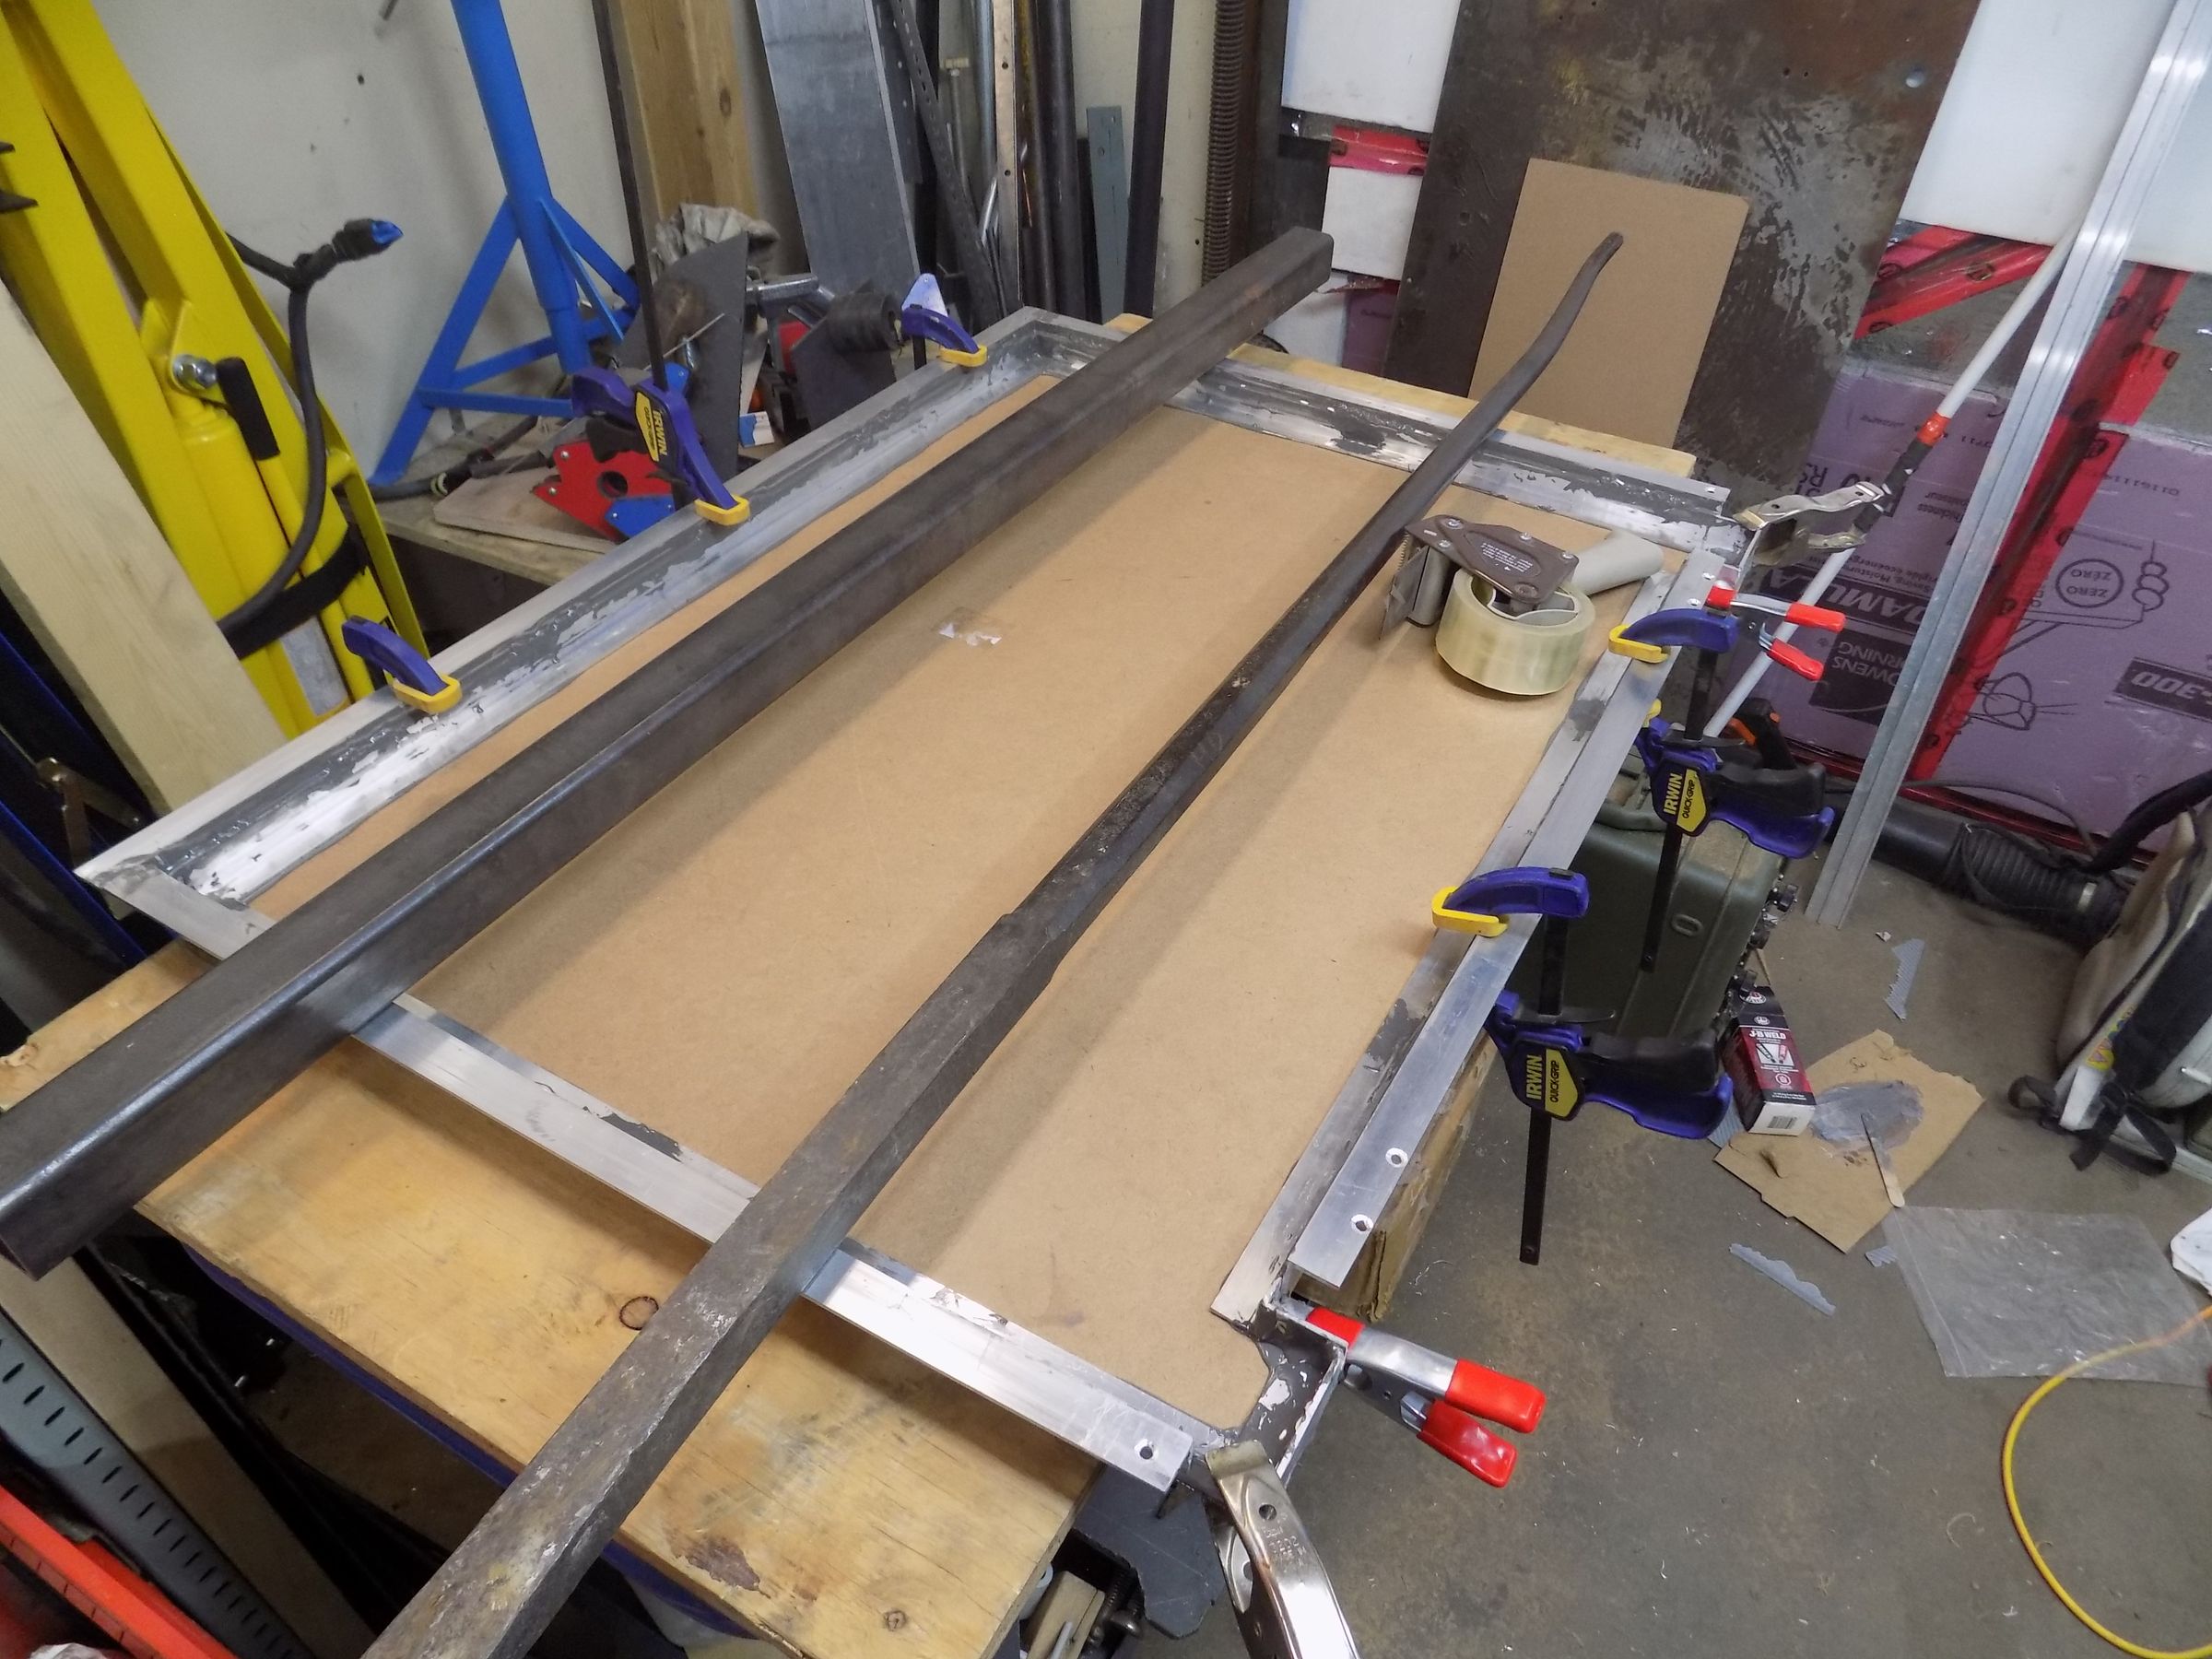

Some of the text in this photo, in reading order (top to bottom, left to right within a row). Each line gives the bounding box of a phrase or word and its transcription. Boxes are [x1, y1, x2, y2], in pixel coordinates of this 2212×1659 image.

[653, 410, 667, 455] IRWIN
[2066, 585, 2109, 598] ZERO
[1663, 772, 1683, 815] IRWIN
[1764, 1030, 1786, 1040] WELD
[1526, 1054, 1543, 1100] IRWIN
